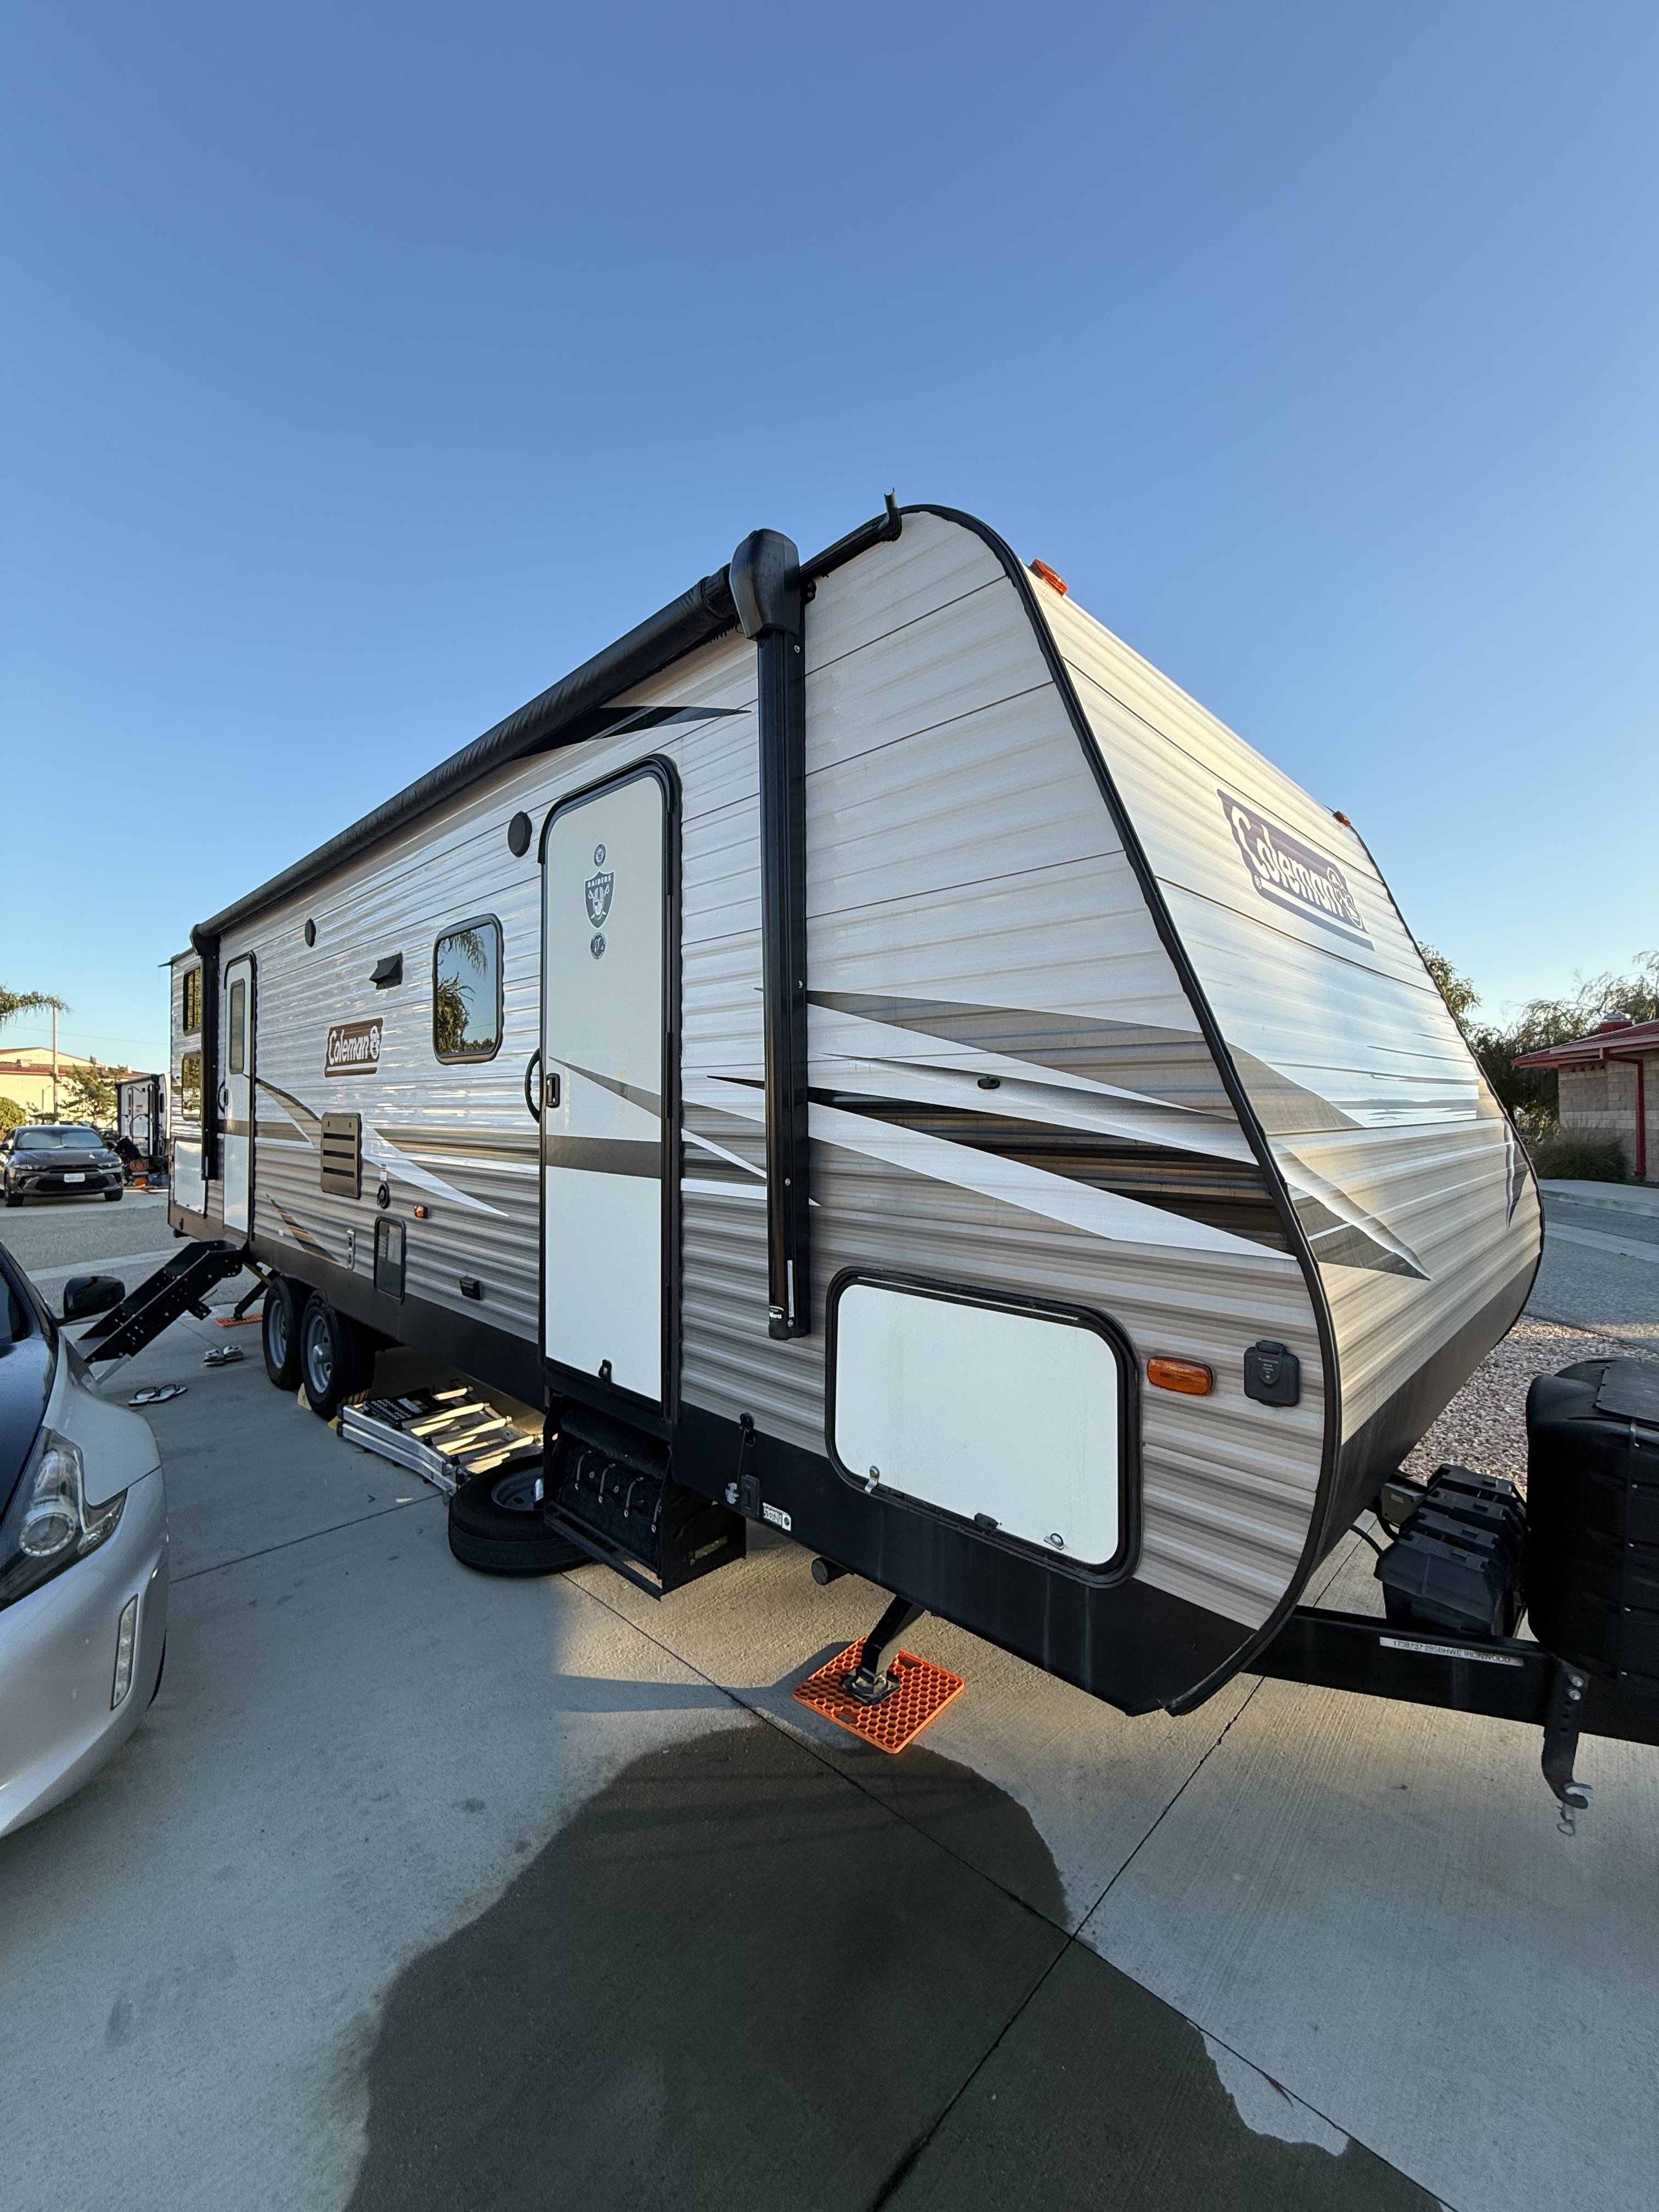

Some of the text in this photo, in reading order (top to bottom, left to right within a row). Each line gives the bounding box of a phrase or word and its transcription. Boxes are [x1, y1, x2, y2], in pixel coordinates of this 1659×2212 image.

[1231, 806, 1344, 917] Coleman
[587, 874, 612, 888] RAIDERS
[328, 1029, 369, 1065] Coleman
[1393, 1640, 1423, 1650] 1738737
[1464, 1650, 1511, 1663] IRONWOOD
